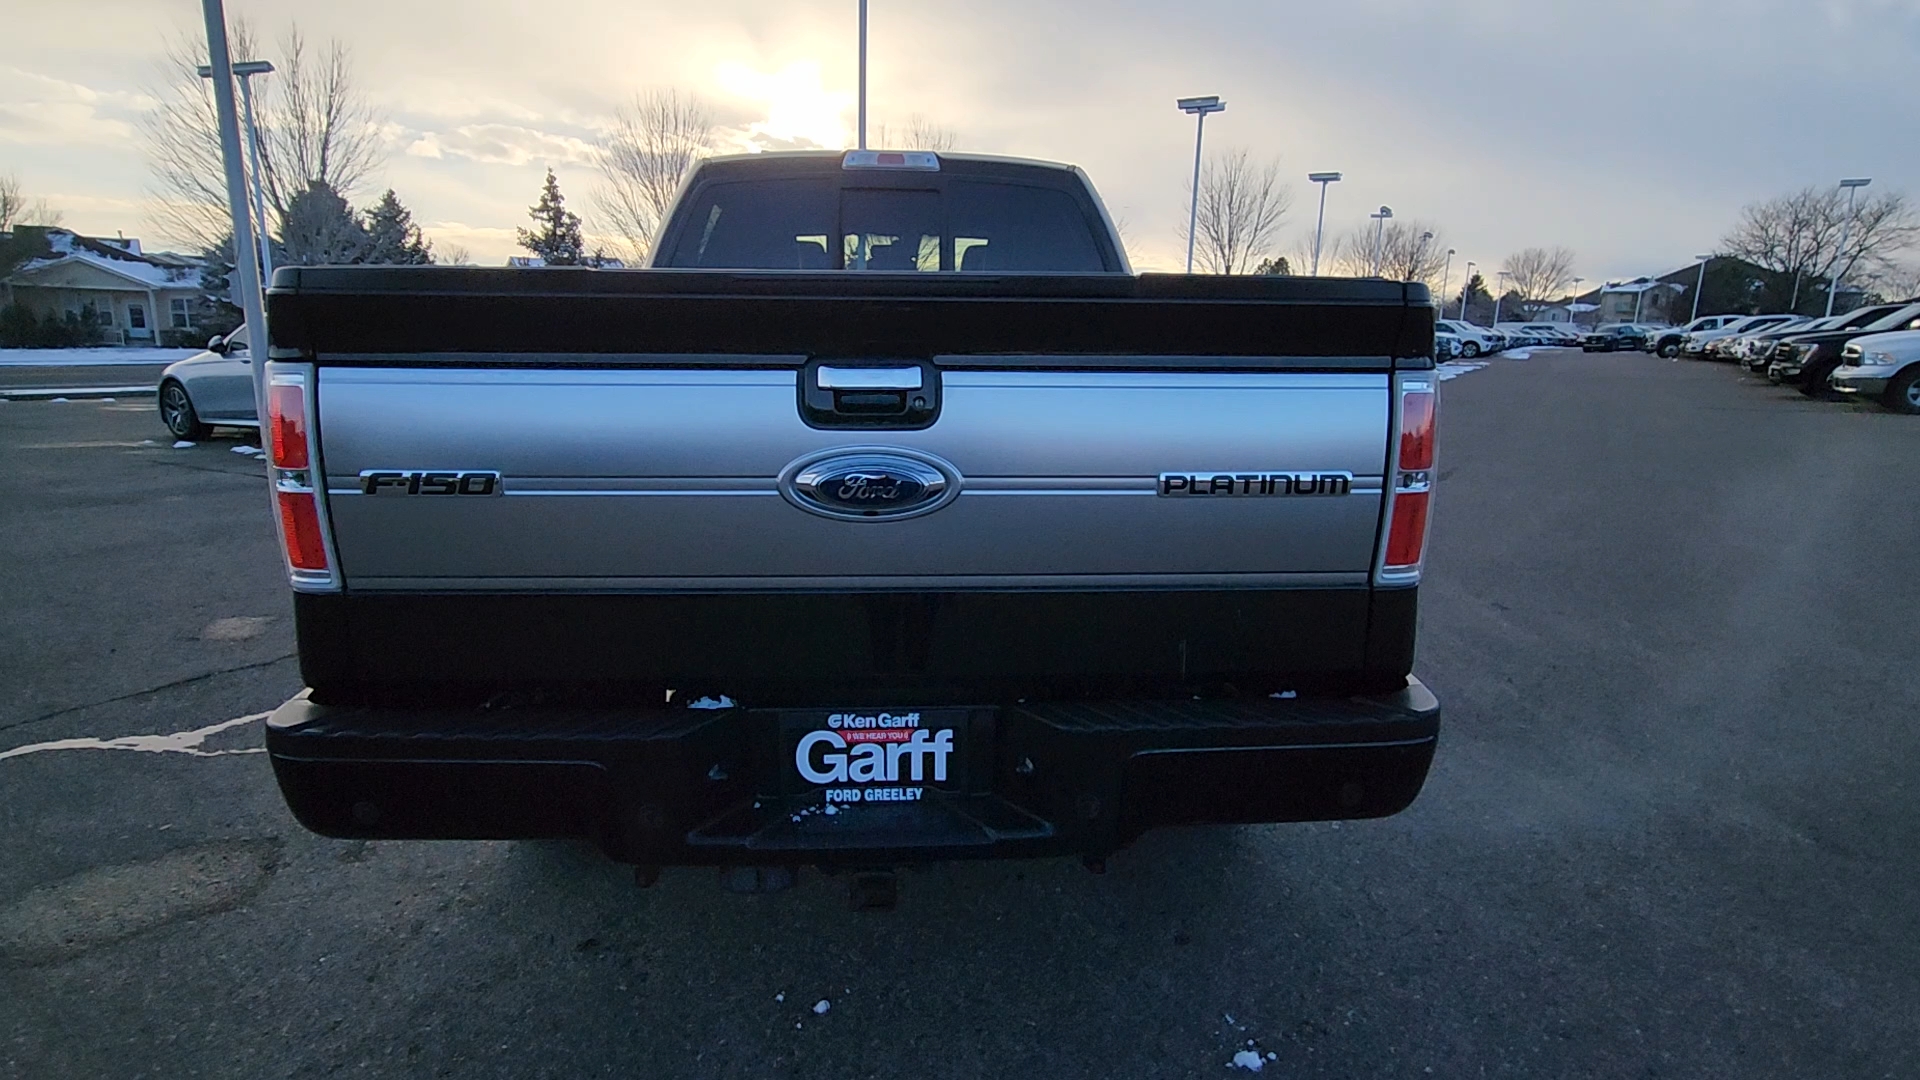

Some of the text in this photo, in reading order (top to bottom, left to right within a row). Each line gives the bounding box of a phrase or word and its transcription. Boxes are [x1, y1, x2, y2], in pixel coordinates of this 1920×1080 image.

[364, 471, 498, 496] F-150
[838, 473, 902, 499] Ford
[1163, 473, 1350, 496] PLATINUM
[843, 712, 921, 729] Ken Garff
[852, 731, 904, 740] WE HEAR YOU
[795, 729, 954, 784] Garff
[825, 787, 924, 802] FORD GREELEY
